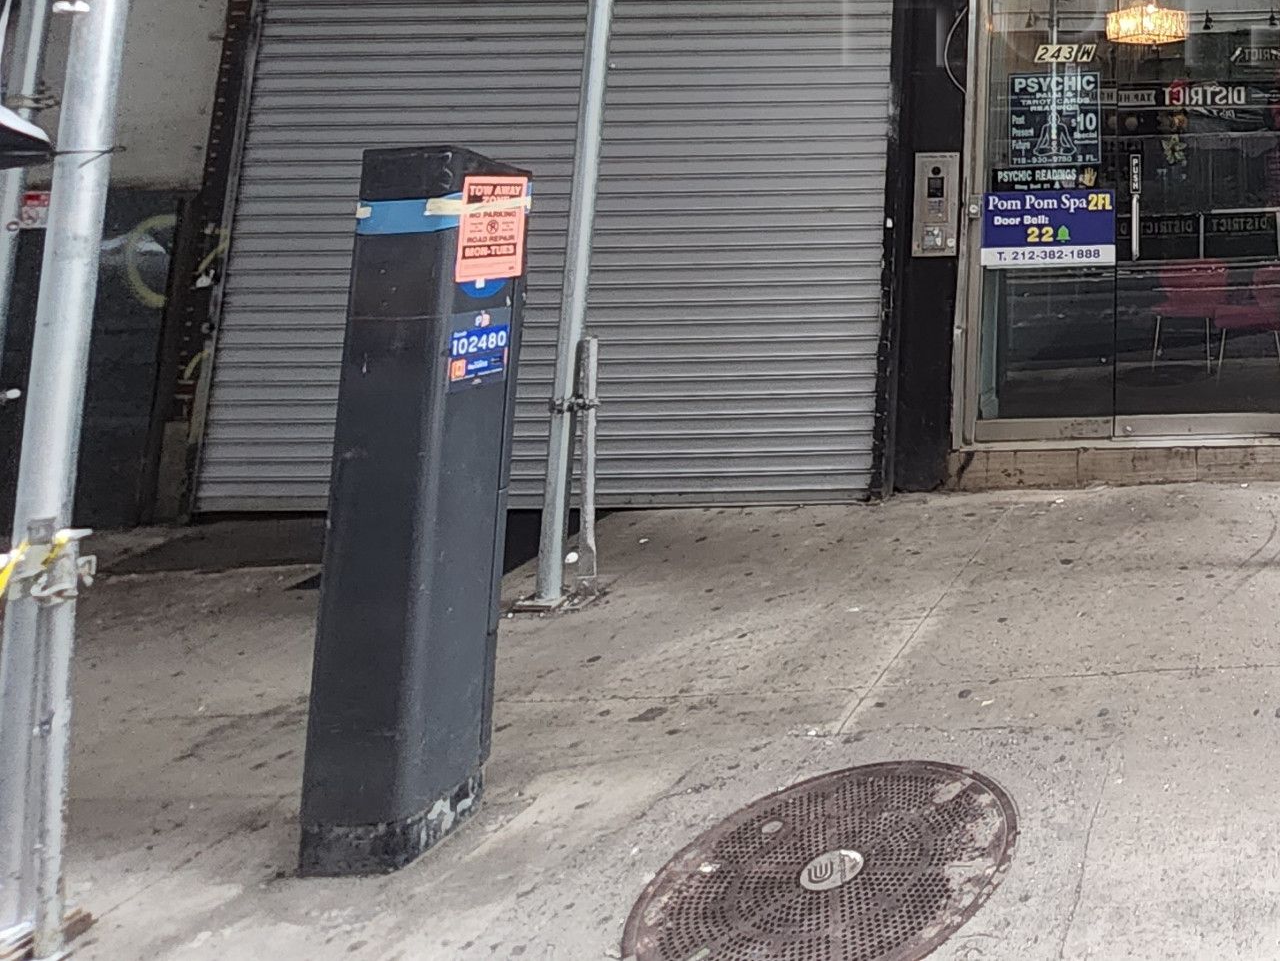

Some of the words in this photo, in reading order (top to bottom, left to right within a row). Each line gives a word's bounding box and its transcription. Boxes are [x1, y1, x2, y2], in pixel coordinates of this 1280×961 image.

[1038, 45, 1075, 62] 243
[1079, 44, 1095, 62] W
[1014, 75, 1096, 93] PSYCHIC
[998, 170, 1033, 183] PSYCHIC
[1035, 169, 1077, 181] READINGS
[469, 185, 494, 195] TOW
[494, 185, 522, 196] AWAY
[988, 195, 1021, 210] Pom
[1025, 195, 1058, 210] Pom
[1060, 194, 1087, 213] Spa
[1088, 193, 1113, 211] 2FL
[994, 216, 1021, 225] Door
[1026, 226, 1054, 242] 22
[997, 251, 1007, 261] T.
[1012, 249, 1101, 261] 212-382-1888
[451, 329, 507, 356] 102480
